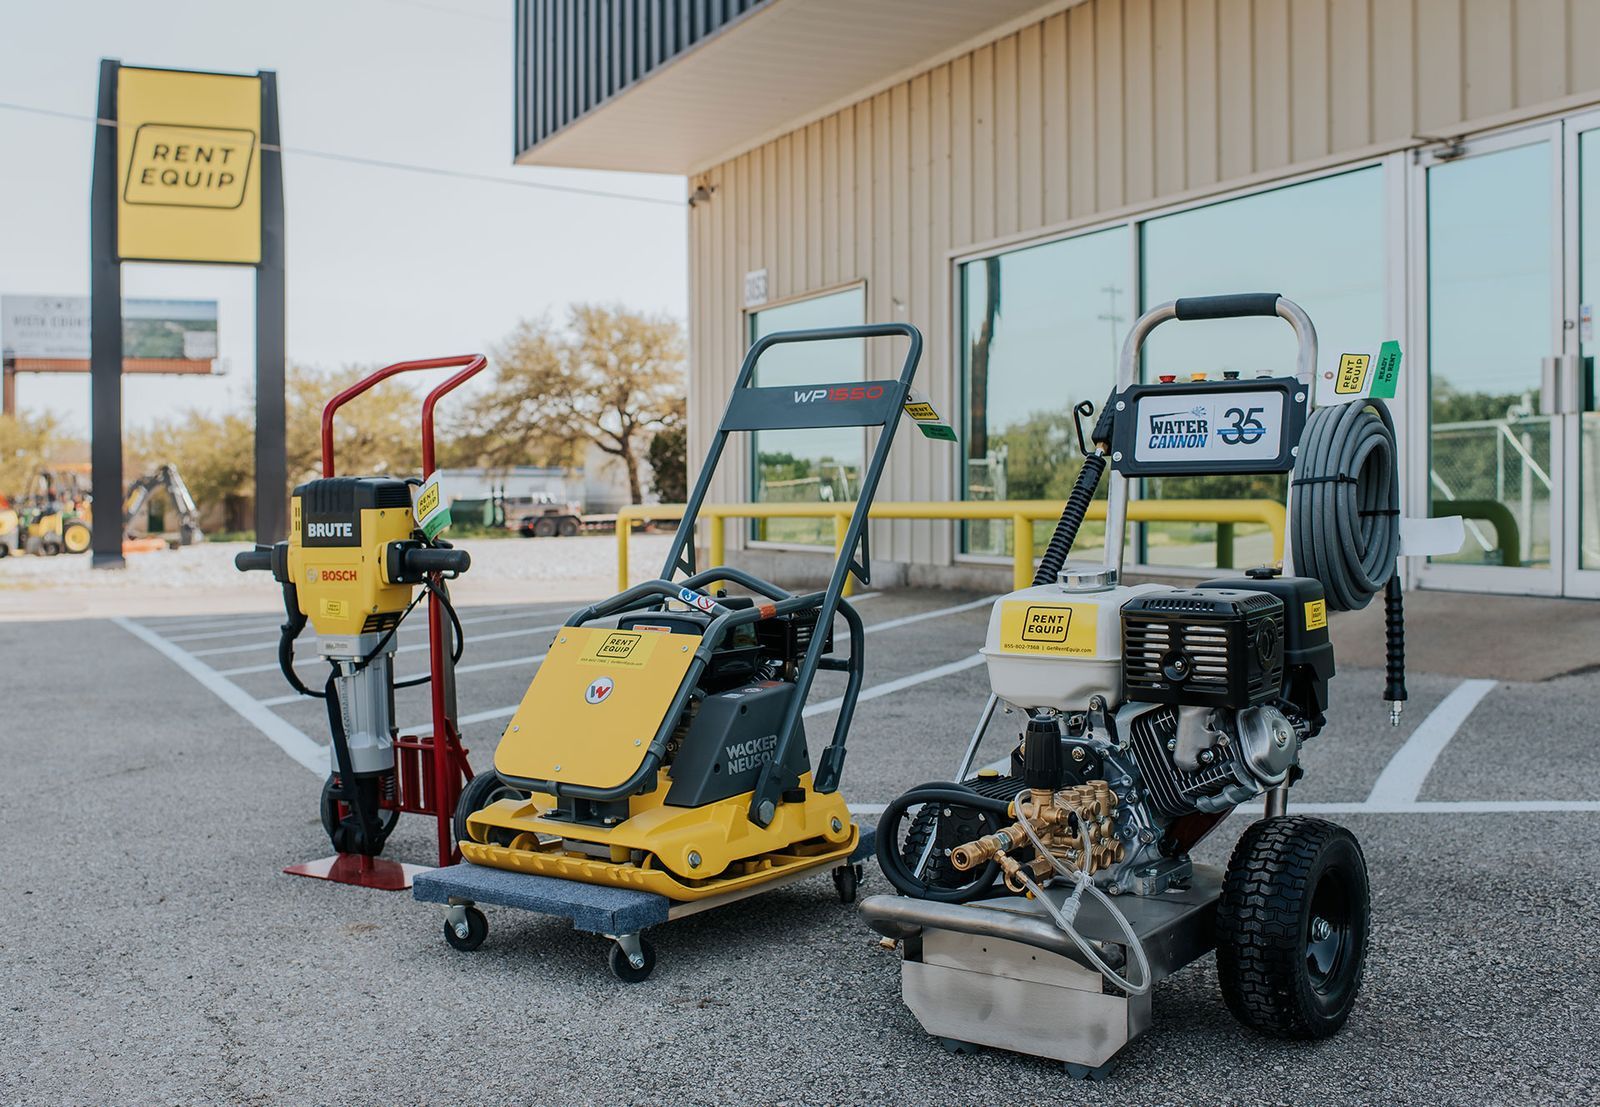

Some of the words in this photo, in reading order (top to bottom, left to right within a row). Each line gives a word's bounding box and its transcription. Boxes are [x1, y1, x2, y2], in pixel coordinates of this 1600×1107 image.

[152, 143, 236, 164] RENT
[140, 168, 235, 189] EQUIP
[1378, 357, 1388, 380] READY
[1388, 353, 1396, 372] RENT
[1343, 360, 1355, 388] RENT
[1350, 358, 1363, 389] EQUIP
[1385, 374, 1392, 383] TO
[793, 385, 883, 403] WP1550
[1149, 417, 1208, 435] WATER
[1221, 407, 1264, 445] 35
[1148, 434, 1208, 449] CANNON
[419, 489, 435, 506] RENT
[419, 496, 436, 515] EQUIP
[307, 523, 352, 537] BRUTE
[321, 570, 357, 581] BOSCH
[1032, 614, 1064, 624] RENT
[1028, 625, 1063, 634] EQUIP
[603, 645, 630, 653] EQUIP
[609, 638, 634, 646] RENT
[726, 735, 777, 760] WACKER
